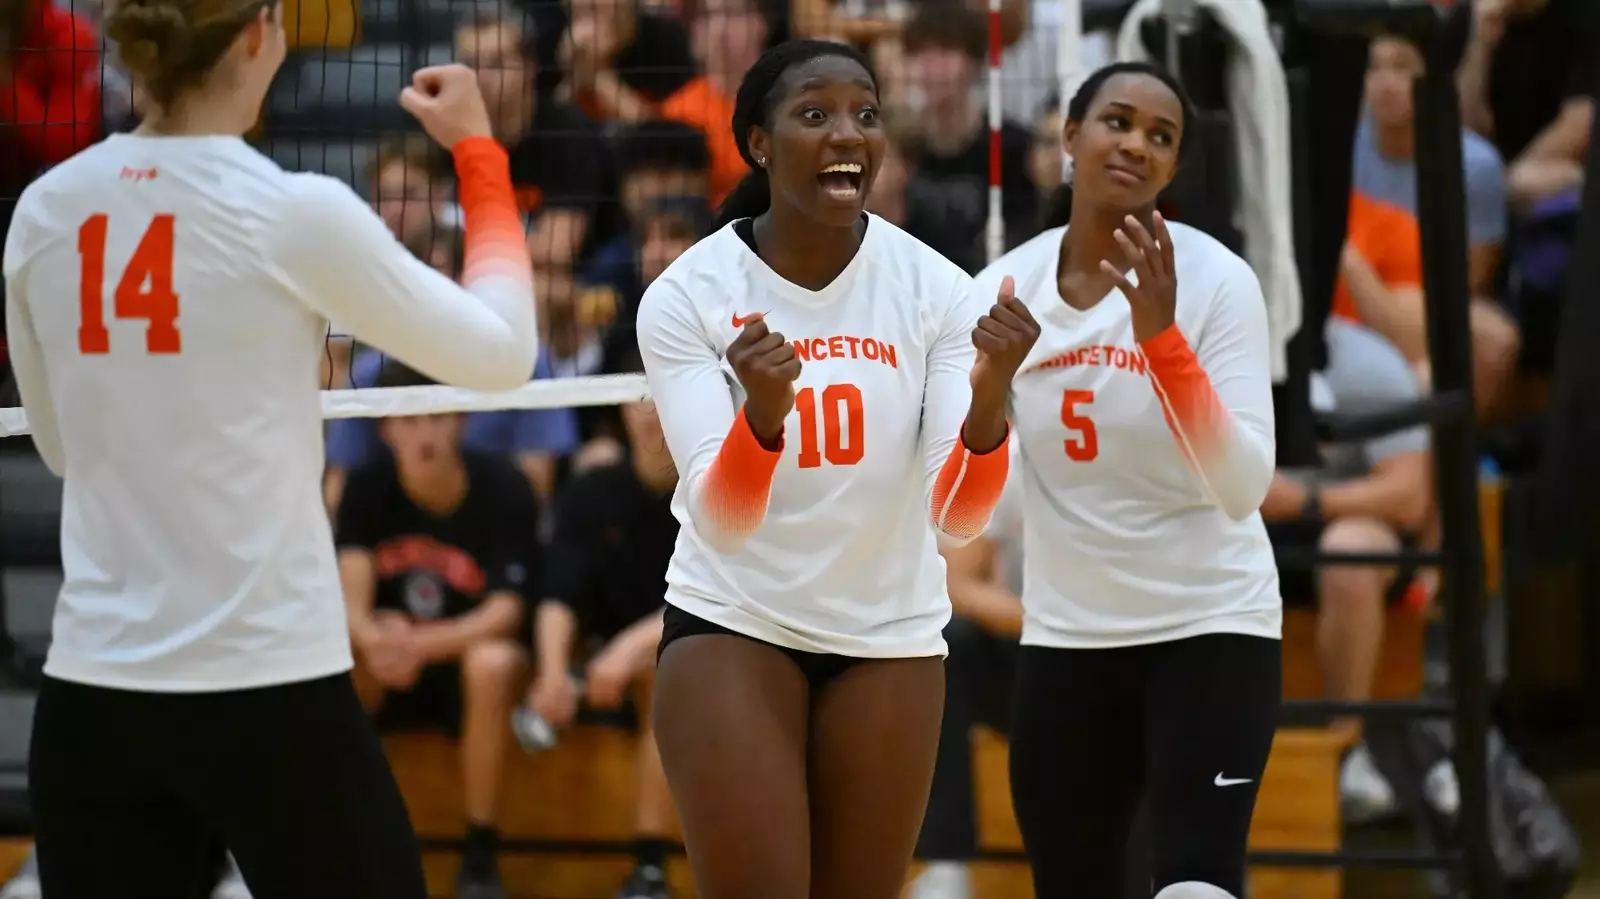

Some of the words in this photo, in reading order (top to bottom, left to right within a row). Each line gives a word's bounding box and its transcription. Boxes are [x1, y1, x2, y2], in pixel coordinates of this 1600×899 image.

[78, 213, 181, 354] 14
[786, 336, 897, 369] NCETON
[795, 384, 865, 468] 10
[1061, 389, 1098, 463] 5
